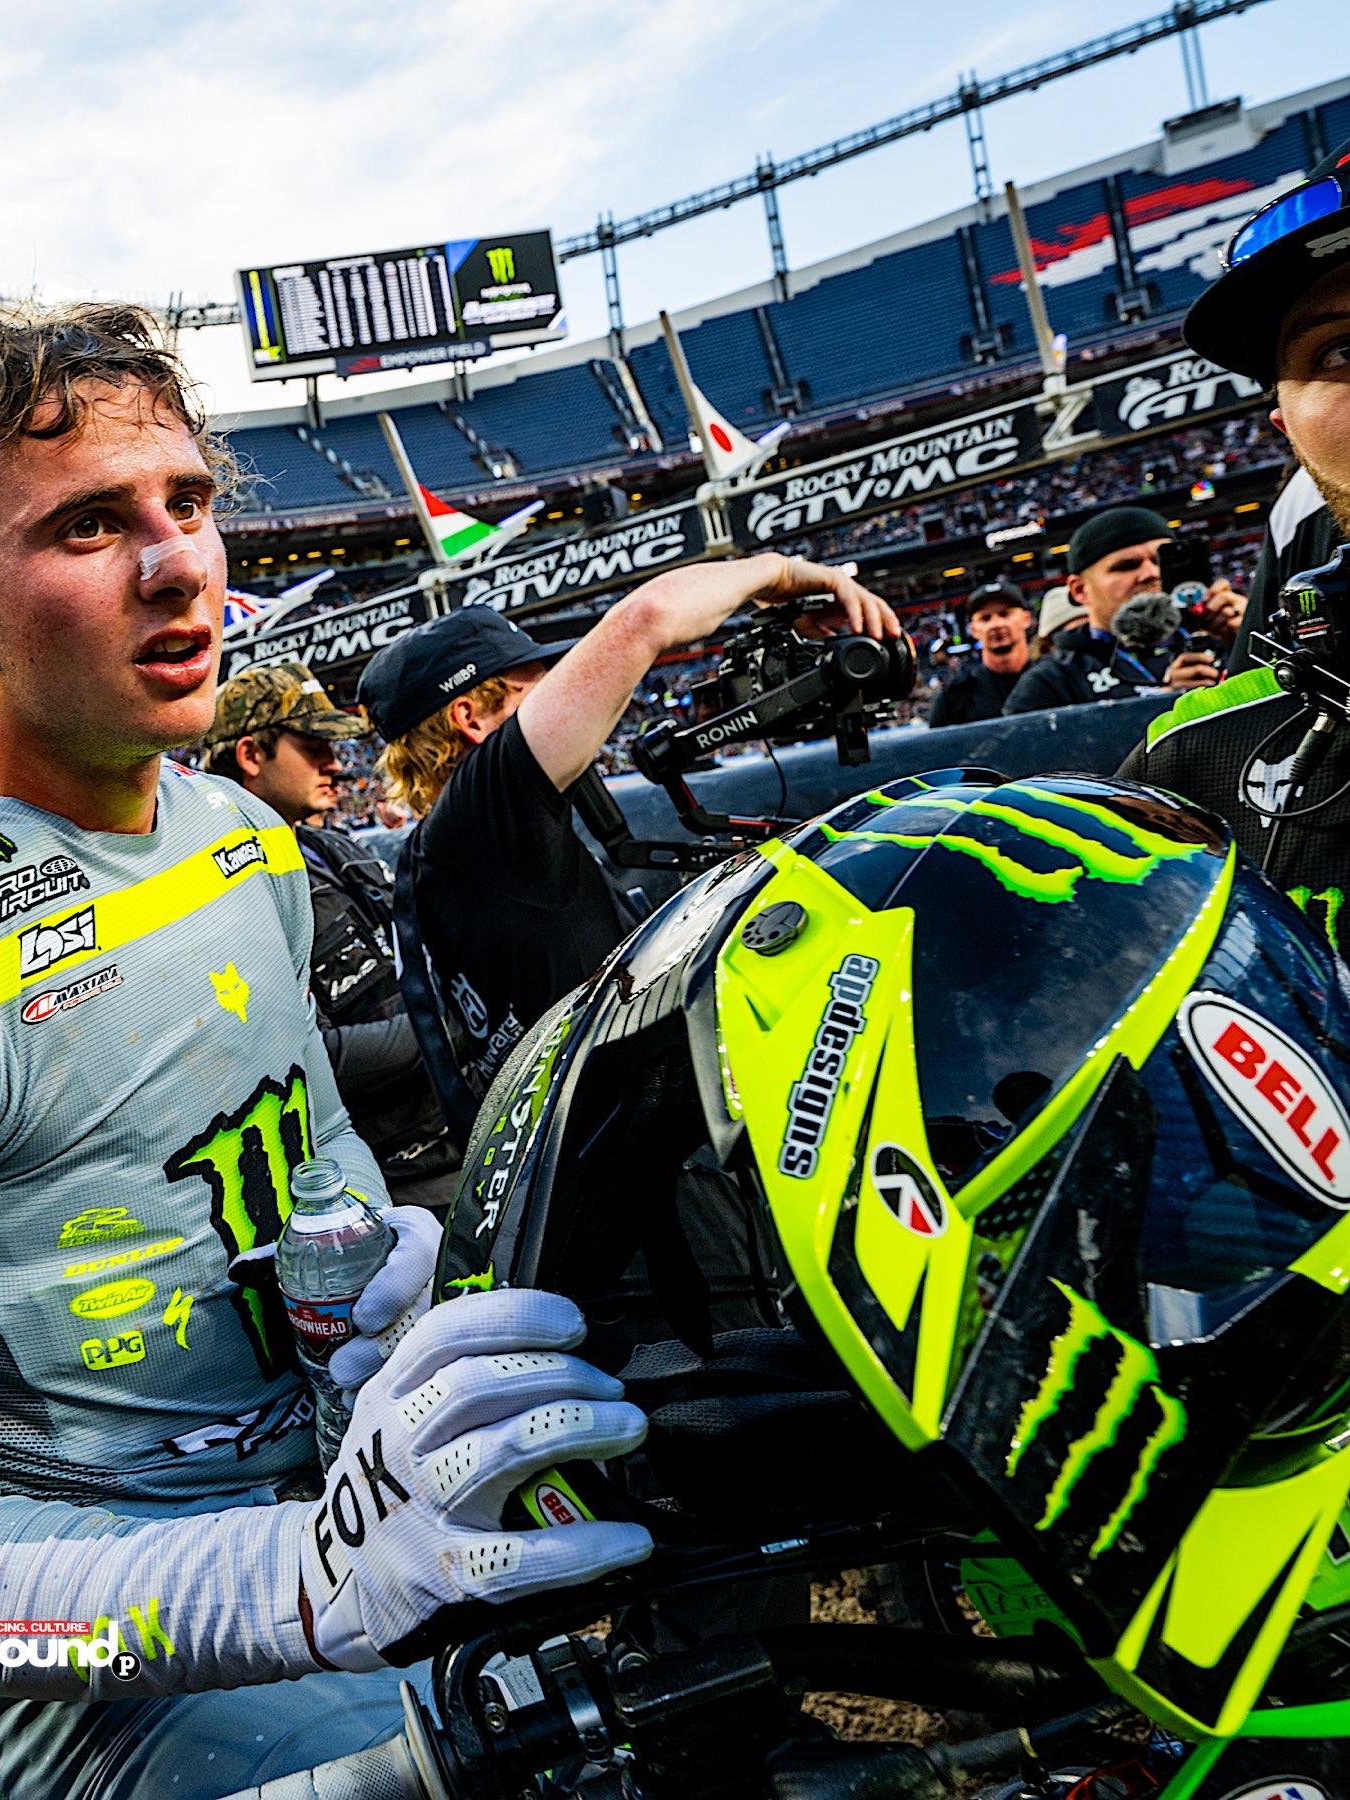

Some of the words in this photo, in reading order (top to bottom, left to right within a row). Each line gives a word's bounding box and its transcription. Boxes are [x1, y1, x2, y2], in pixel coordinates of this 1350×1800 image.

[785, 460, 867, 502] ROCKY
[868, 415, 1015, 477] MOUNTAIN
[492, 550, 561, 587] ROCKY
[562, 514, 683, 567] MOUNTAIN
[254, 630, 310, 661] ROCKY
[311, 600, 411, 644] MOUNTAIN
[696, 710, 759, 749] RONIN
[782, 954, 877, 1176] apdesigns
[1213, 1021, 1341, 1183] BELL
[63, 1236, 185, 1278] DUNLOP
[83, 1335, 143, 1364] PPG
